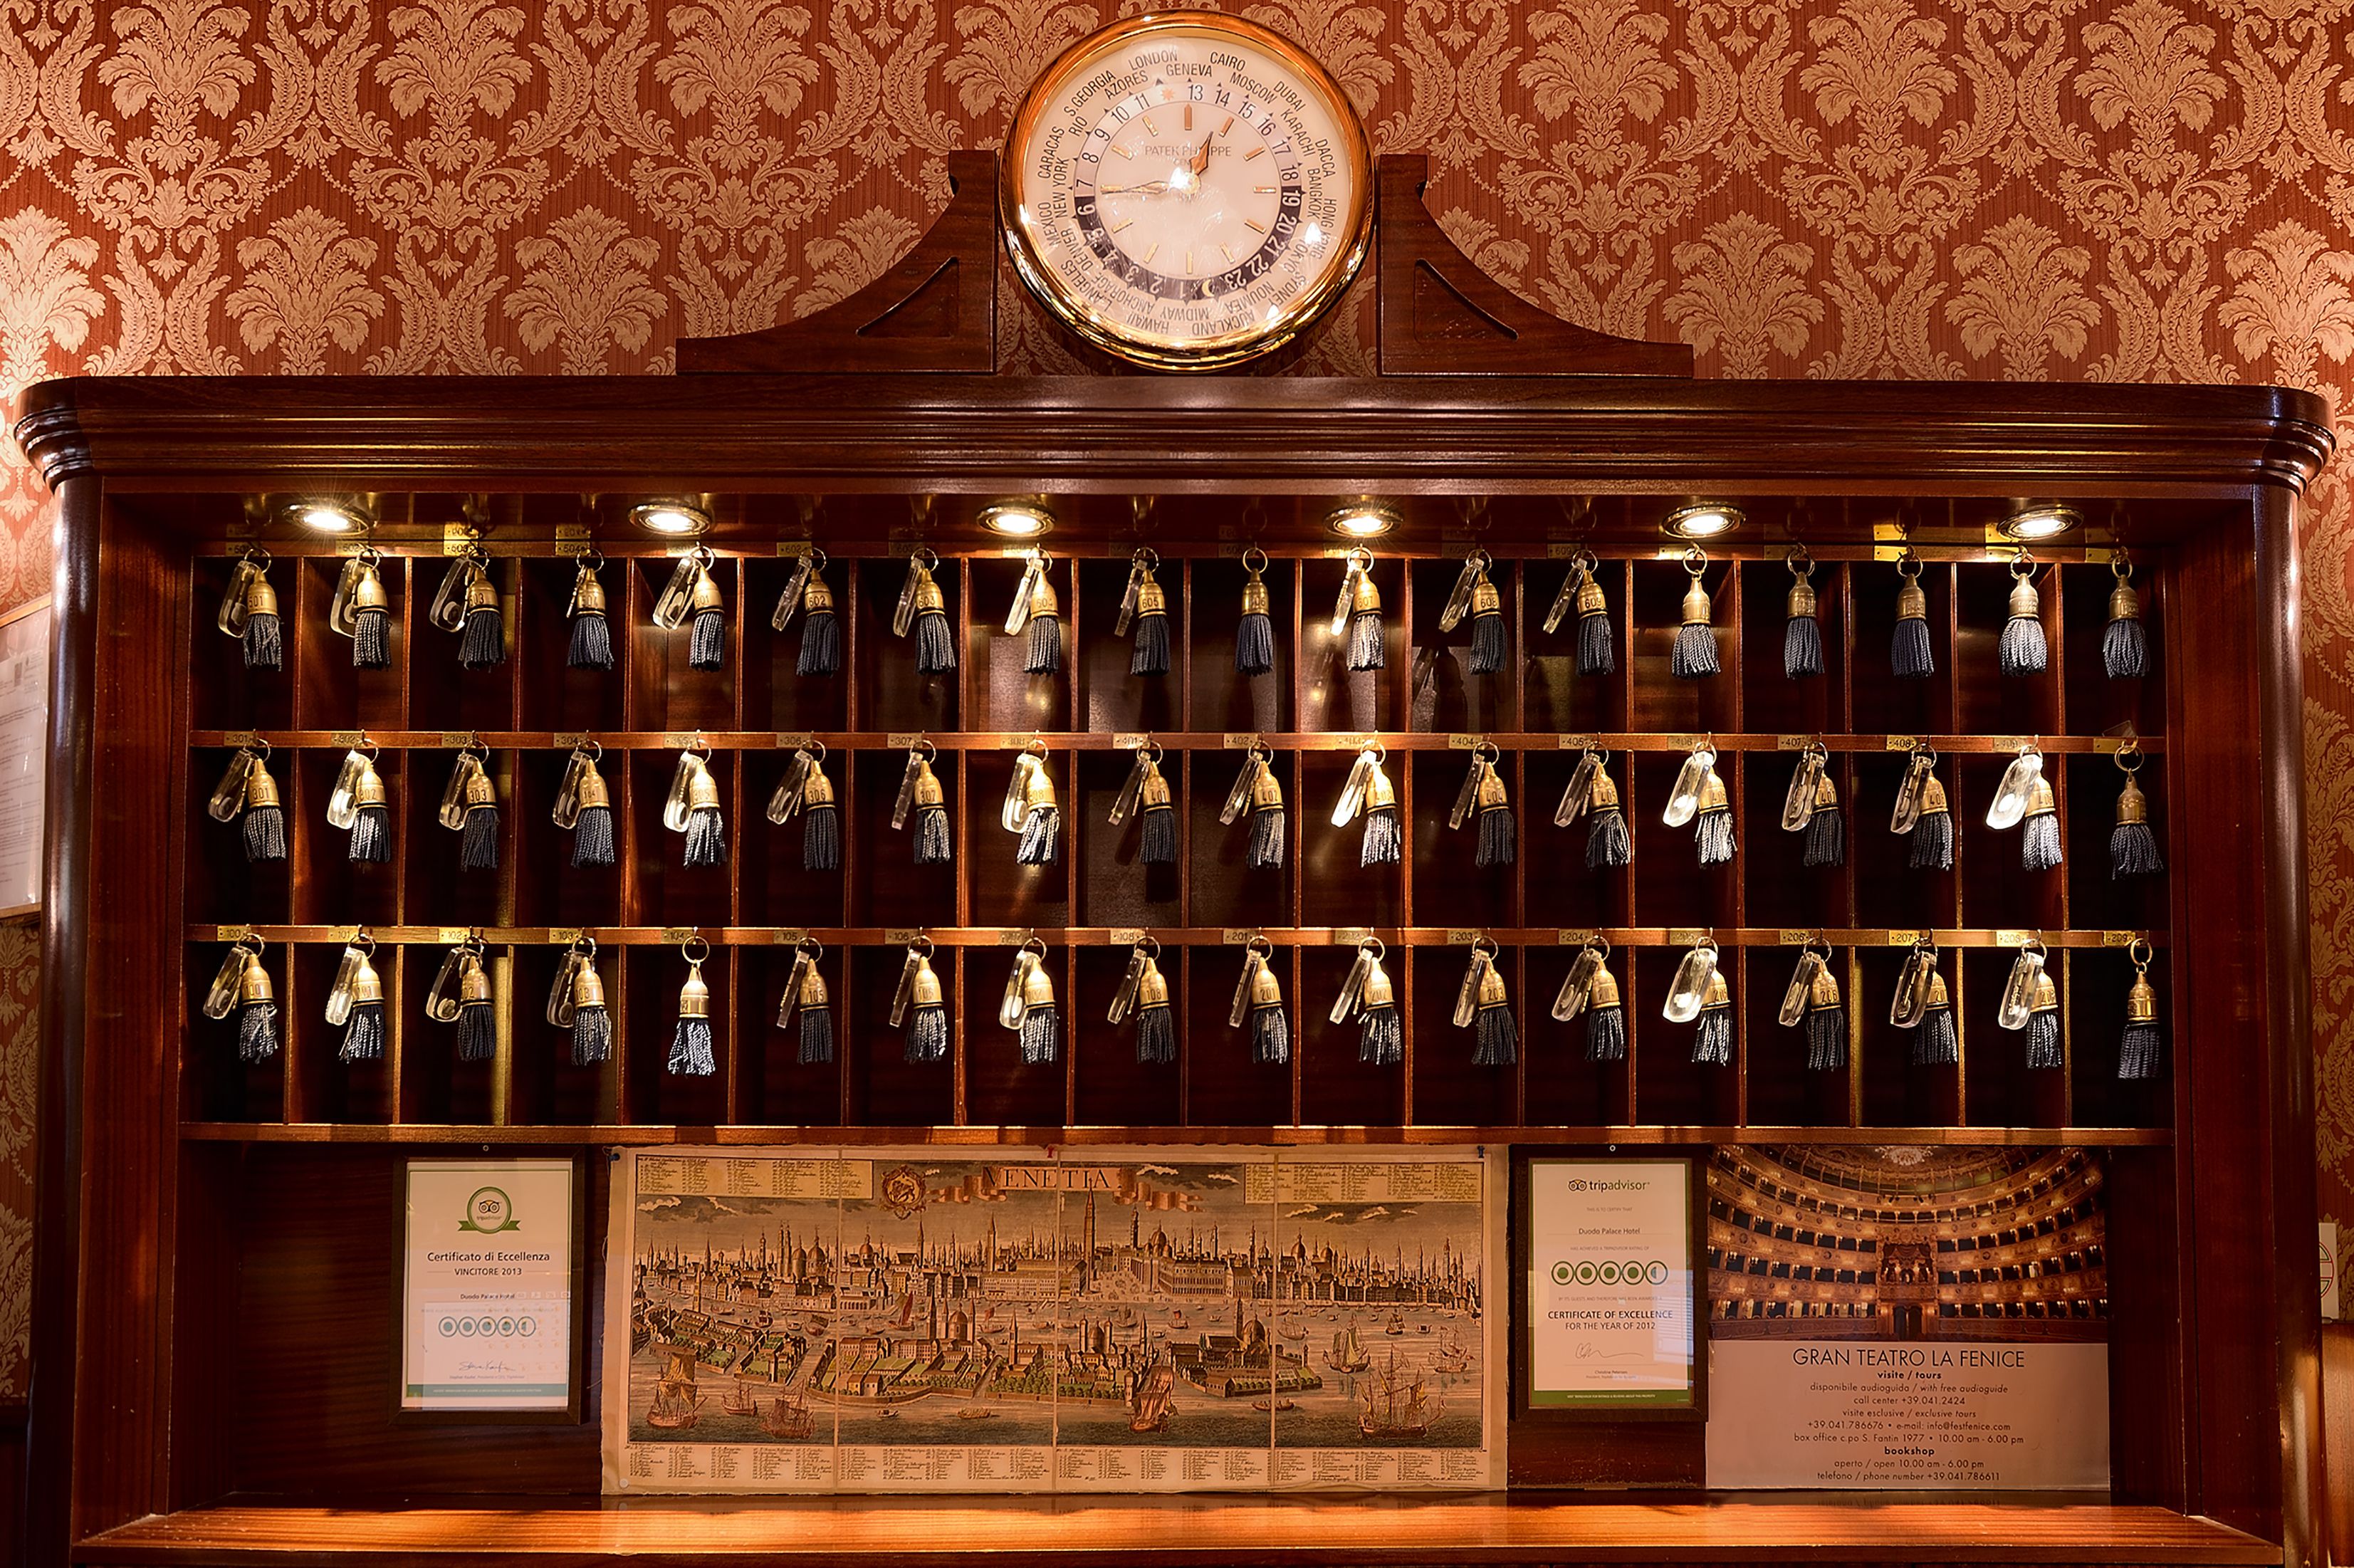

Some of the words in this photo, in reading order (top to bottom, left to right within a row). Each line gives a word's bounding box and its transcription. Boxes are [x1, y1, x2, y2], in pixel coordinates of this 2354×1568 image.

[1129, 48, 1178, 70] LONDON
[1210, 51, 1246, 72] CAIRO
[1166, 63, 1212, 78] GENEVA
[1104, 70, 1149, 100] AZORES
[1230, 72, 1277, 105] MOSCOW
[1063, 70, 1116, 117] S.GEORGIA
[1188, 84, 1203, 101] 13
[1215, 89, 1230, 107] 14
[1273, 80, 1307, 113] DUBAI
[1134, 93, 1151, 110] 11
[1111, 105, 1130, 125] 10
[1238, 101, 1256, 119] 15
[1068, 115, 1088, 137] RIO
[1257, 117, 1277, 137] 16
[1280, 108, 1317, 157] KARACHI
[1094, 128, 1111, 142] 9
[1037, 126, 1065, 179] CARACAS
[1145, 145, 1179, 156] PATEK
[1182, 145, 1231, 157] PHPPE
[1272, 141, 1291, 155] 17
[1082, 152, 1099, 163] 8
[1314, 139, 1336, 178] DACCA
[1052, 157, 1069, 187] YORK
[1280, 164, 1299, 182] 18
[1076, 179, 1093, 189] 7
[1282, 189, 1301, 207] 19
[1307, 168, 1323, 219] BANGKOK
[1052, 192, 1067, 218] NEW
[1320, 198, 1336, 229] HONG
[1037, 202, 1061, 246] MEXICO
[1276, 212, 1297, 235] 20
[1060, 227, 1094, 271] DENVER
[1262, 235, 1286, 258] 21
[1283, 239, 1309, 273] TOKYO
[1245, 254, 1270, 276] 22
[1124, 265, 1139, 282] 3
[1224, 269, 1247, 291] 23
[1150, 276, 1164, 293] 2
[1091, 271, 1155, 315] ANCHORAGE
[1225, 282, 1275, 314] NOUMEA
[1160, 305, 1209, 321] MIDWAY
[1127, 313, 1170, 335] HAWAII
[1192, 309, 1255, 336] AUCKLAND
[785, 544, 802, 554] 602
[809, 596, 826, 607] 602
[918, 596, 936, 607] 603
[1141, 596, 1159, 607] 605
[1480, 596, 1497, 608] 608
[1585, 597, 1602, 609] 609
[232, 734, 249, 743] 301
[449, 736, 467, 745] 303
[895, 736, 912, 745] 307
[1232, 736, 1249, 746] 402
[1456, 738, 1474, 746] 404
[1566, 738, 1584, 746] 405
[1785, 738, 1802, 747] 407
[1893, 738, 1910, 747] 408
[253, 788, 269, 800] 301
[469, 789, 487, 802] 303
[809, 788, 826, 802] 306
[1151, 790, 1167, 803] 401
[226, 929, 241, 938] 100
[558, 931, 572, 940] 103
[783, 931, 797, 941] 105
[1231, 931, 1247, 941] 201
[1455, 932, 1473, 941] 203
[1566, 932, 1584, 941] 204
[1787, 933, 1804, 942] 206
[1896, 933, 1912, 942] 207
[2111, 934, 2128, 943] 209
[1146, 988, 1162, 1001] 108
[1260, 988, 1275, 1001] 201
[1487, 987, 1505, 1000] 203
[1821, 989, 1838, 1002] 206
[982, 1166, 1111, 1188] VENETIA
[427, 1252, 481, 1262] Certificato
[484, 1252, 494, 1262] di
[498, 1251, 550, 1262] Eccellenza
[1548, 1311, 1601, 1319] CERTIFICATE
[1618, 1310, 1673, 1319] EXCELLENCE
[1793, 1348, 1850, 1366] GRAN
[1857, 1349, 1925, 1366] TEATRO
[1932, 1350, 1954, 1366] LA
[1960, 1350, 2024, 1368] FENICE
[1877, 1370, 1905, 1379] visite
[1810, 1382, 1858, 1393] disponibile
[1860, 1383, 1910, 1394] audioguida
[1920, 1383, 1937, 1392] with
[1940, 1383, 1957, 1393] free
[1960, 1384, 2009, 1395] audioguide
[1853, 1396, 1870, 1405] call
[1872, 1396, 1898, 1405] center
[1902, 1396, 1965, 1405] +39.041.2424
[1842, 1408, 1864, 1417] visite
[1867, 1408, 1905, 1417] esclusive
[1915, 1408, 1952, 1418] exclusive
[1807, 1420, 1884, 1430] +39.041.786676
[1896, 1421, 1923, 1430] e-mail:
[1927, 1421, 2011, 1431] info@festfenice.com
[1794, 1432, 1810, 1441] box
[1813, 1432, 1837, 1442] office
[1862, 1433, 1871, 1442] S.
[1873, 1433, 1899, 1443] Fantin
[1903, 1433, 1925, 1443] 1977
[1939, 1434, 1964, 1443] 10.00
[1987, 1434, 2008, 1443] 6.00
[1884, 1446, 1935, 1457] bookshop
[1834, 1460, 1863, 1469] aperto
[1873, 1461, 1895, 1470] open
[1899, 1459, 1924, 1468] 10.00
[1947, 1460, 1969, 1468] 6.00
[1817, 1470, 1853, 1480] telefono
[1863, 1471, 1890, 1482] phone
[1893, 1471, 1925, 1480] number
[1927, 1472, 2000, 1481] +39.041.786611
